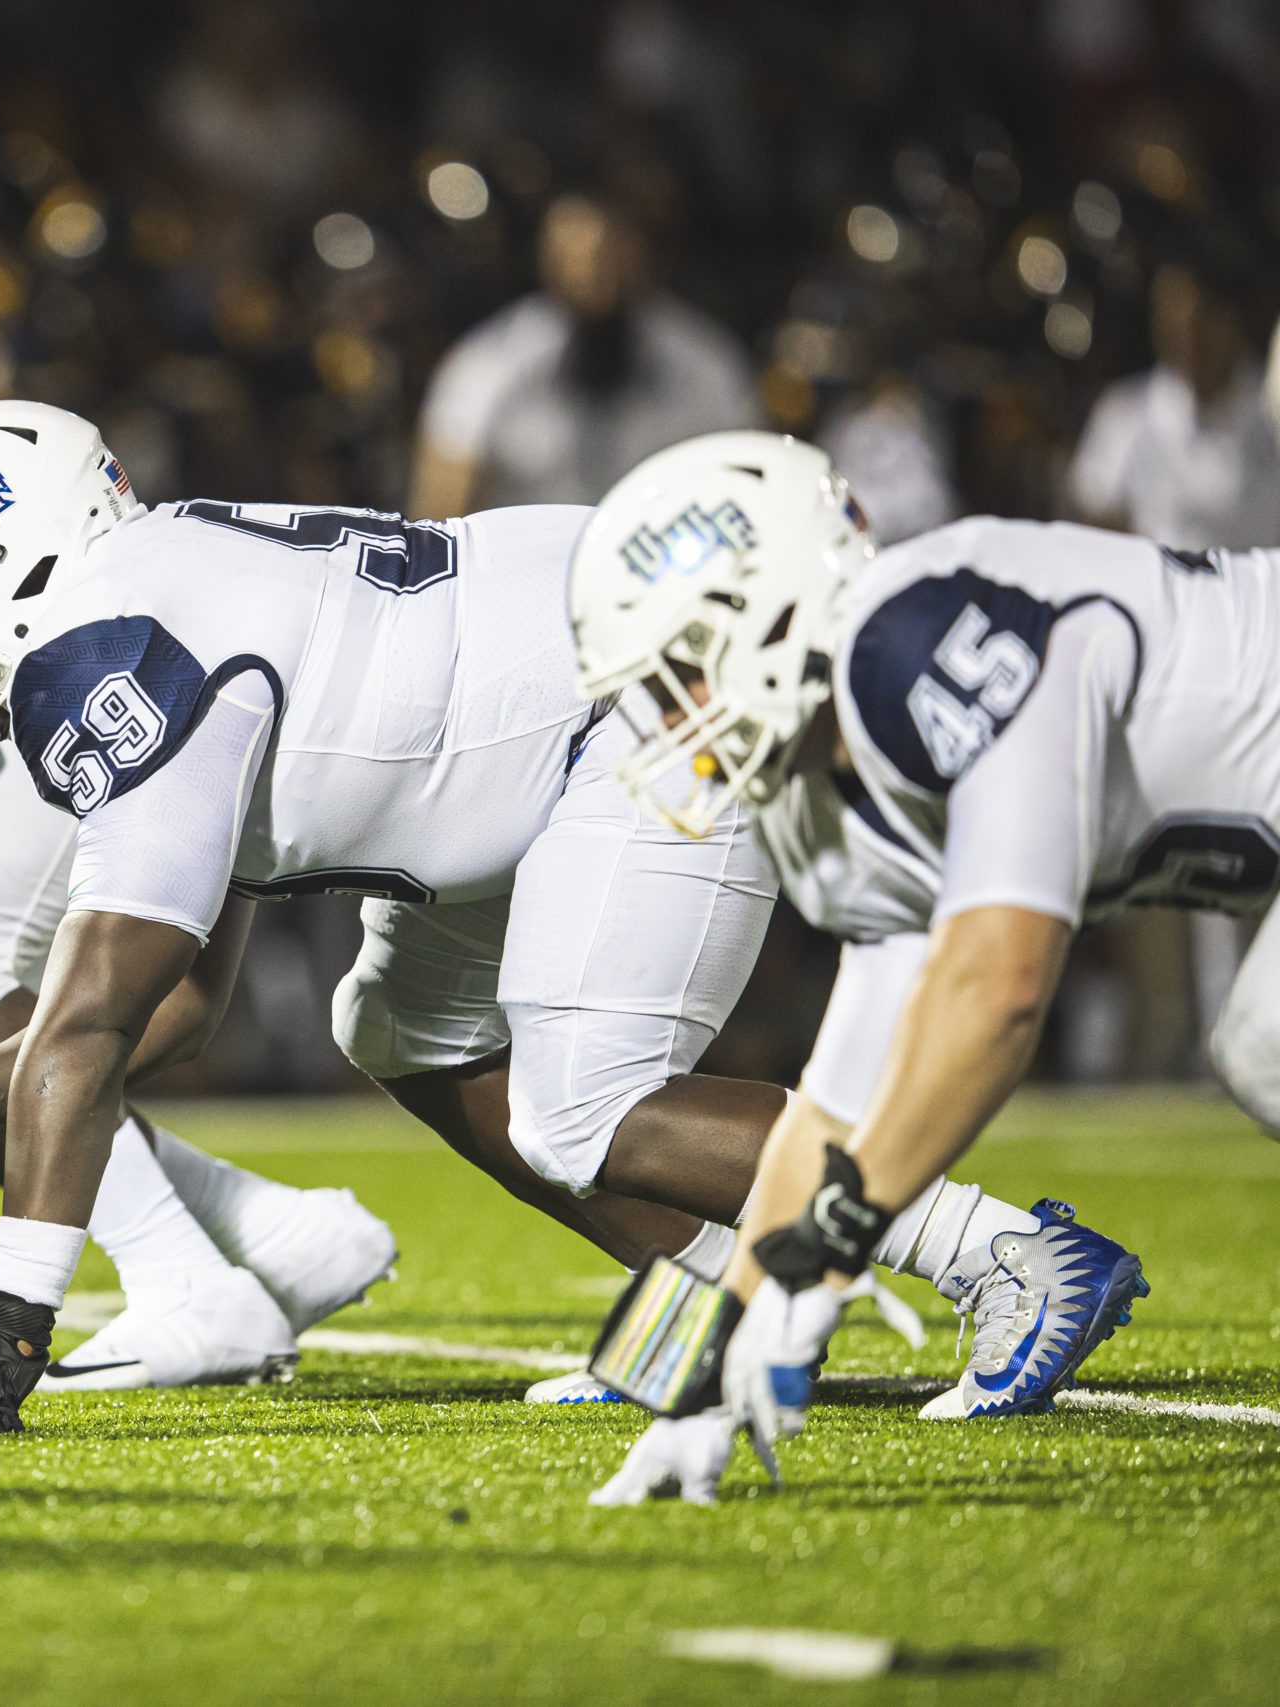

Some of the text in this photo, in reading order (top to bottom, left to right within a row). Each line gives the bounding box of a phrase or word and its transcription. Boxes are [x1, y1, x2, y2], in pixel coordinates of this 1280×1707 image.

[619, 500, 758, 583] UWF
[41, 669, 168, 817] 59
[906, 600, 1040, 780] 45
